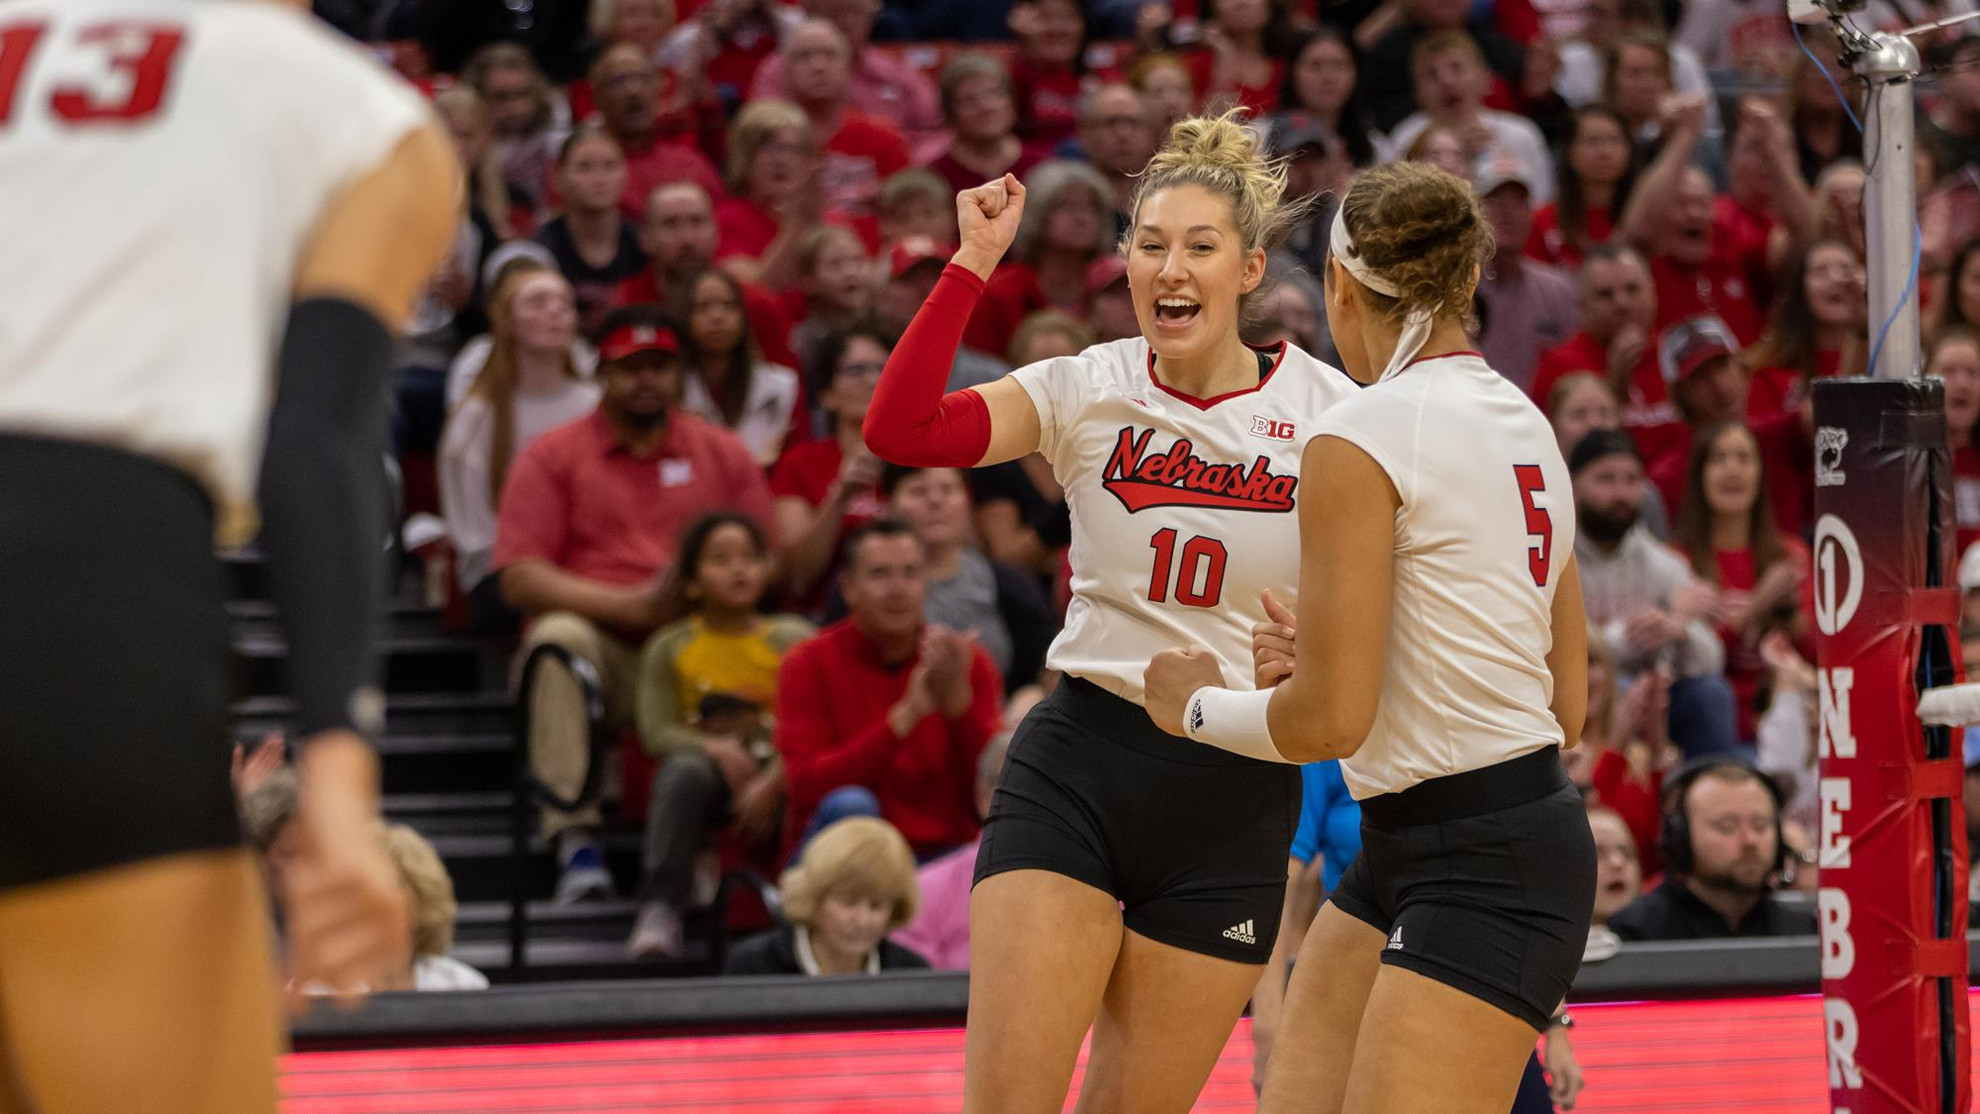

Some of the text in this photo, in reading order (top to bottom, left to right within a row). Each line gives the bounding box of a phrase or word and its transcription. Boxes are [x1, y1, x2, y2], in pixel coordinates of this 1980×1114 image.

[0, 21, 186, 128] 13
[1102, 426, 1299, 504] Nebraska
[1148, 527, 1228, 608] 10
[1512, 464, 1552, 587] 5
[1222, 930, 1256, 945] adidas
[1818, 667, 1864, 1114] NEBR
